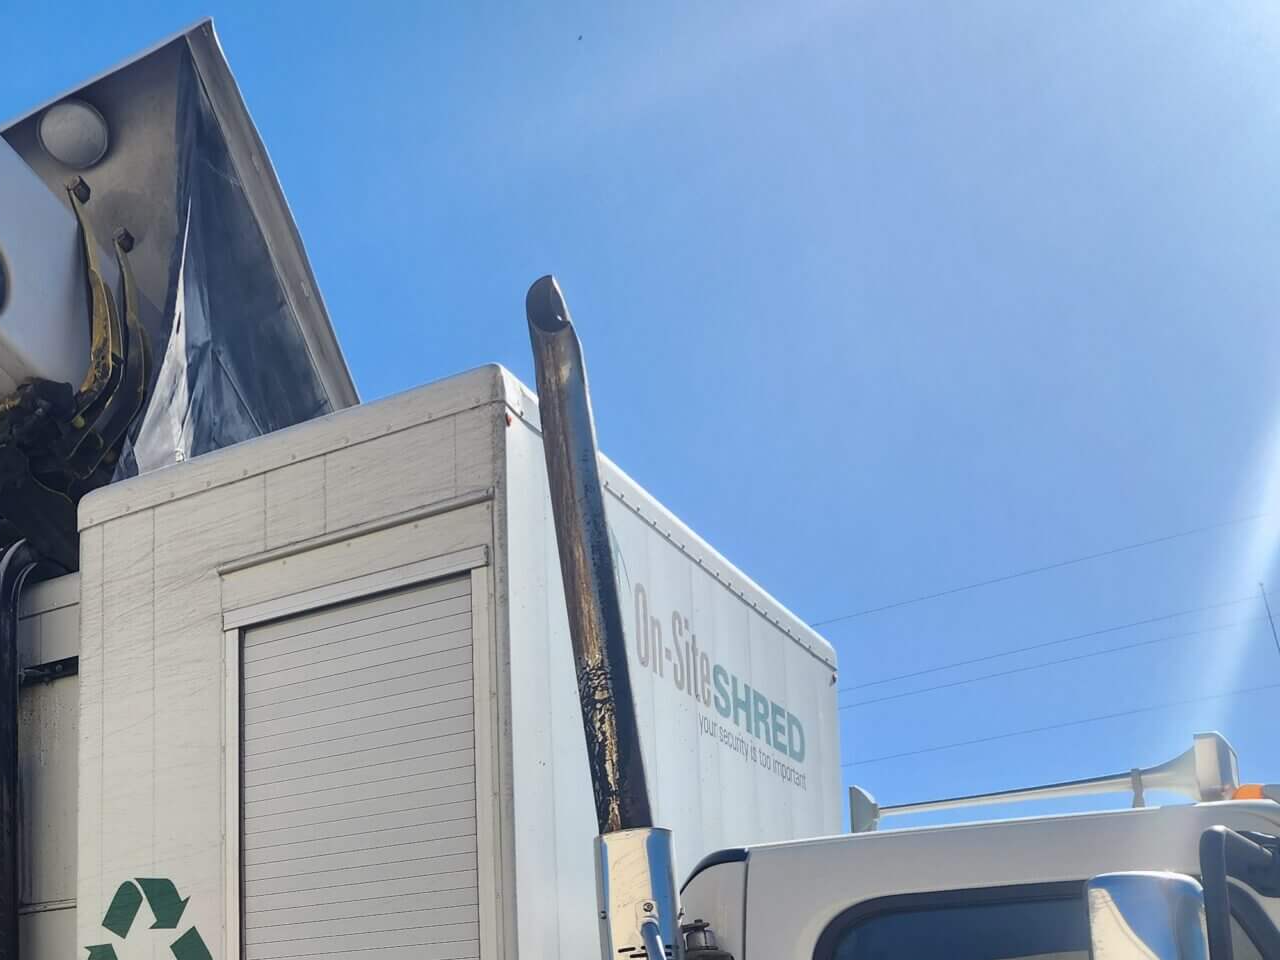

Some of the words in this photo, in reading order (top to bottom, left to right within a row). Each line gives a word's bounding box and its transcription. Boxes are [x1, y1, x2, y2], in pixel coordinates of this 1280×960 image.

[698, 712, 718, 737] your
[719, 727, 750, 759] security
[772, 757, 807, 791] important
